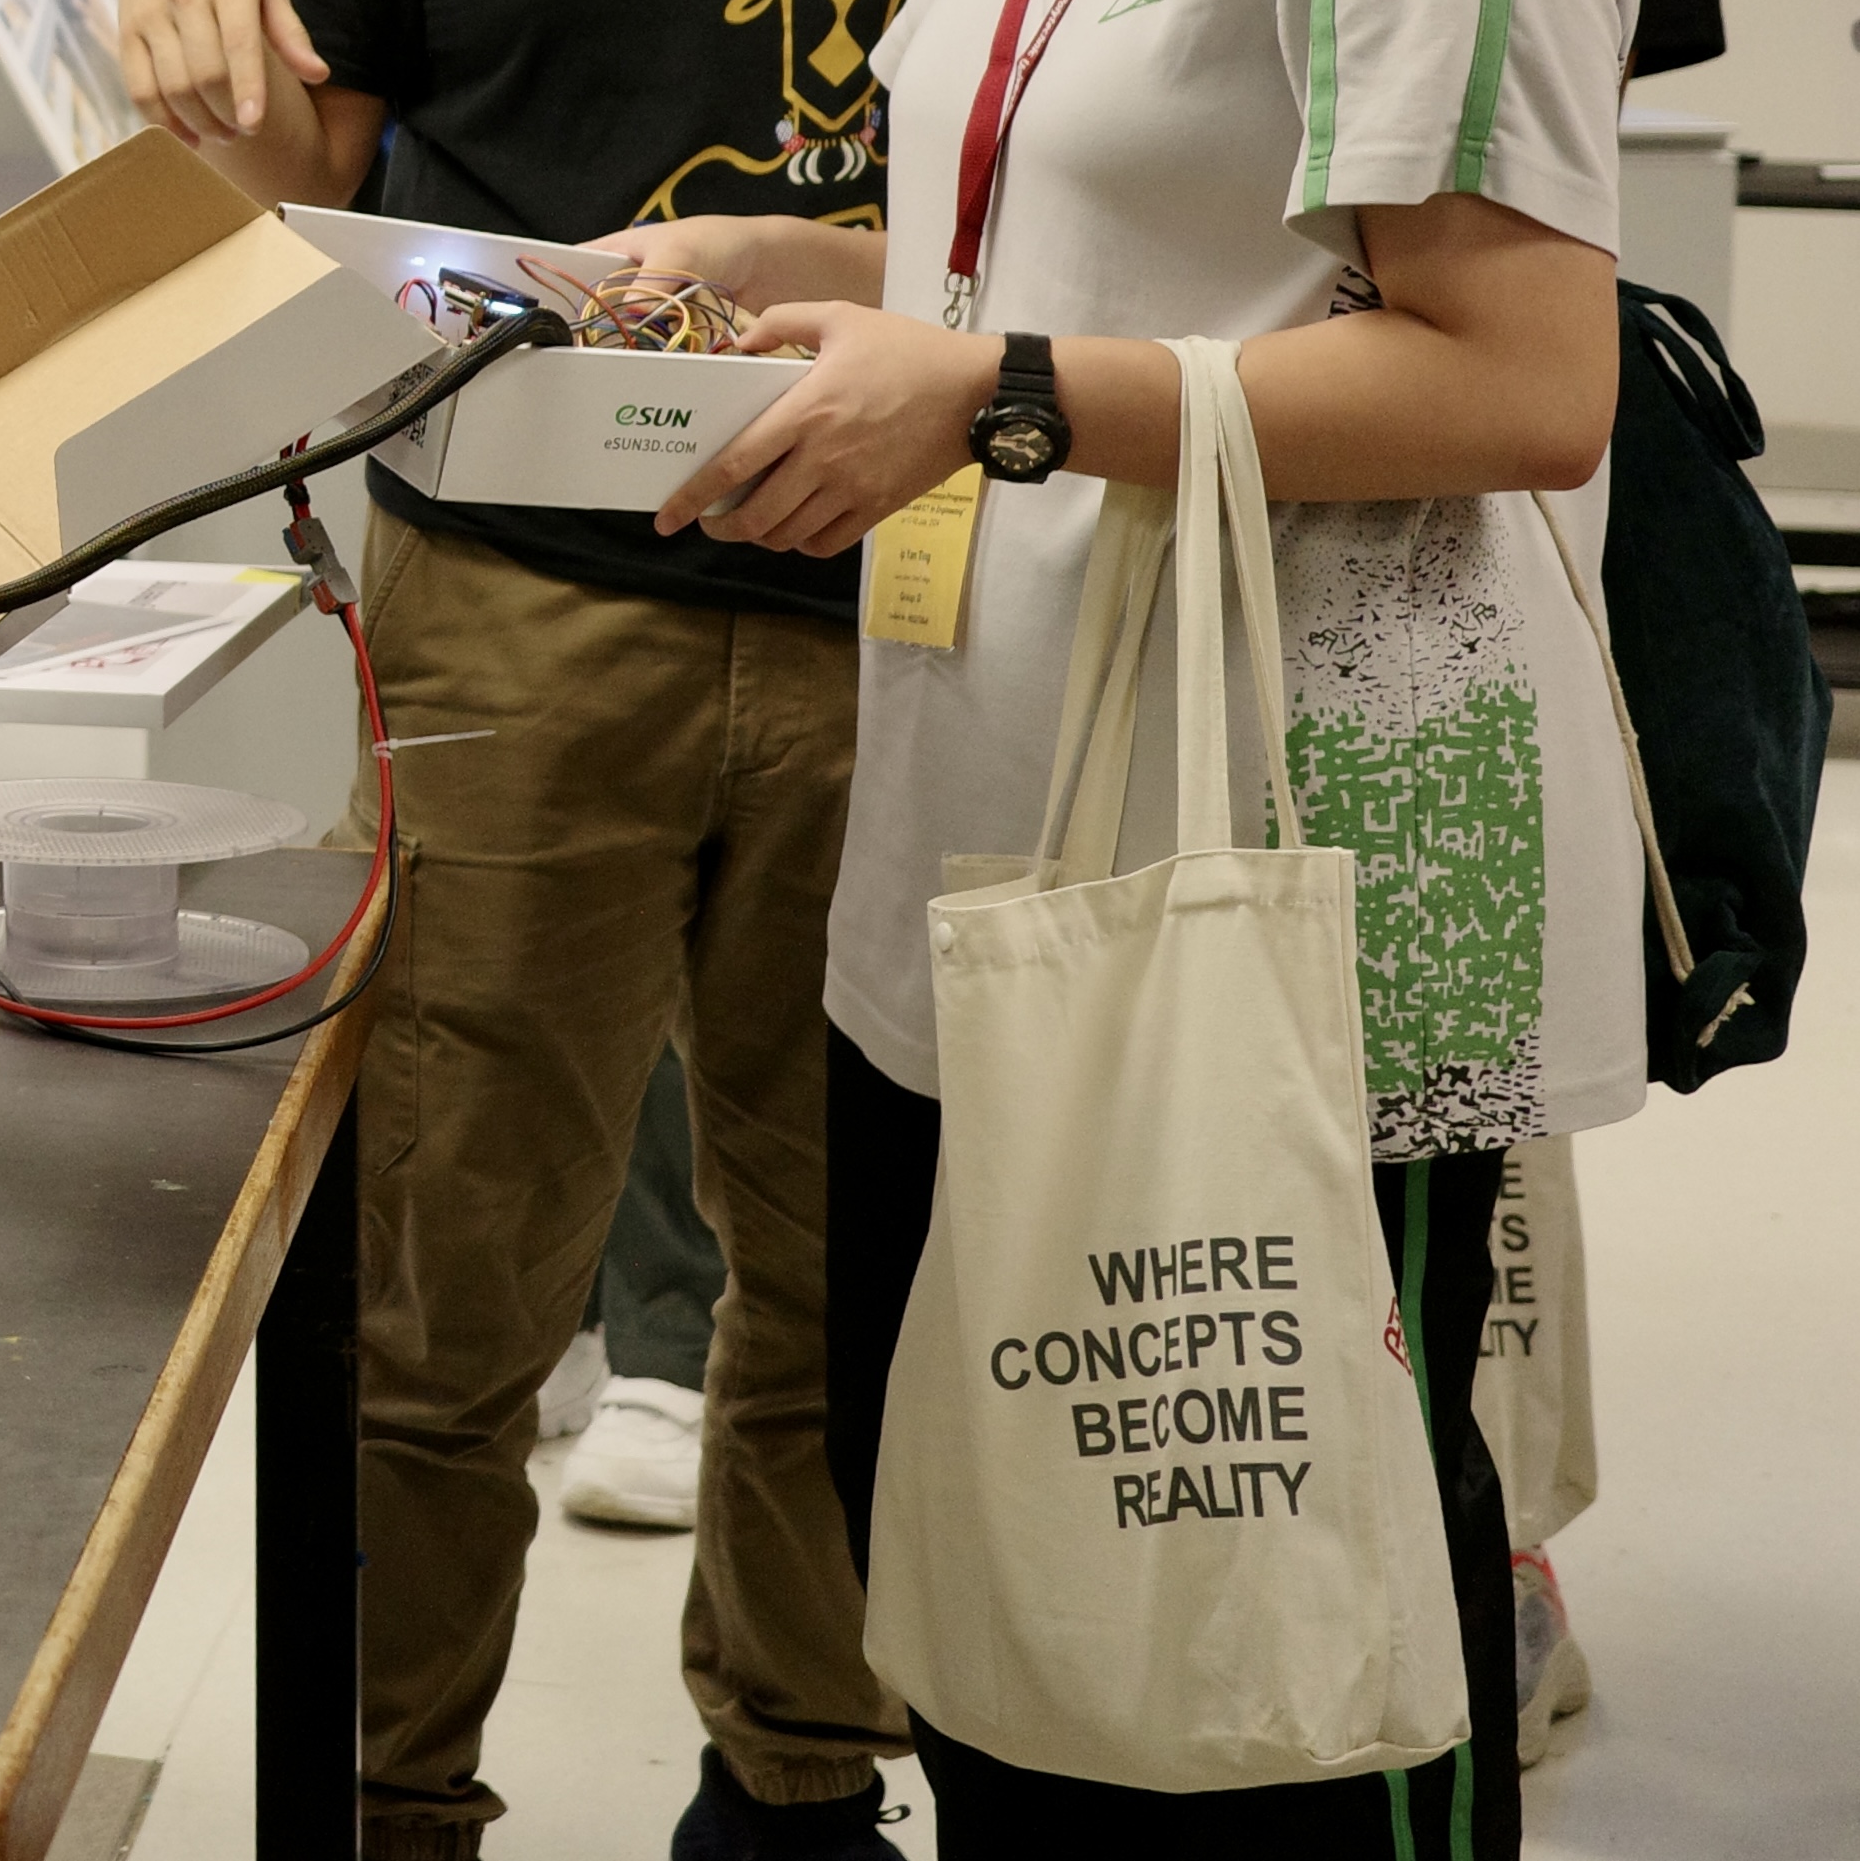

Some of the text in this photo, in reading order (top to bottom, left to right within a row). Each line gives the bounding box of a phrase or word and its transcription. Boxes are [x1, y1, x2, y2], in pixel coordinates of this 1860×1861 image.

[604, 437, 697, 454] eSUN3D.COM
[615, 404, 693, 428] eSUN
[1087, 1236, 1298, 1305] WHERE
[990, 1310, 1303, 1390] CONCEPTS
[1071, 1386, 1308, 1457] BECOME
[1113, 1462, 1312, 1529] REALITY
